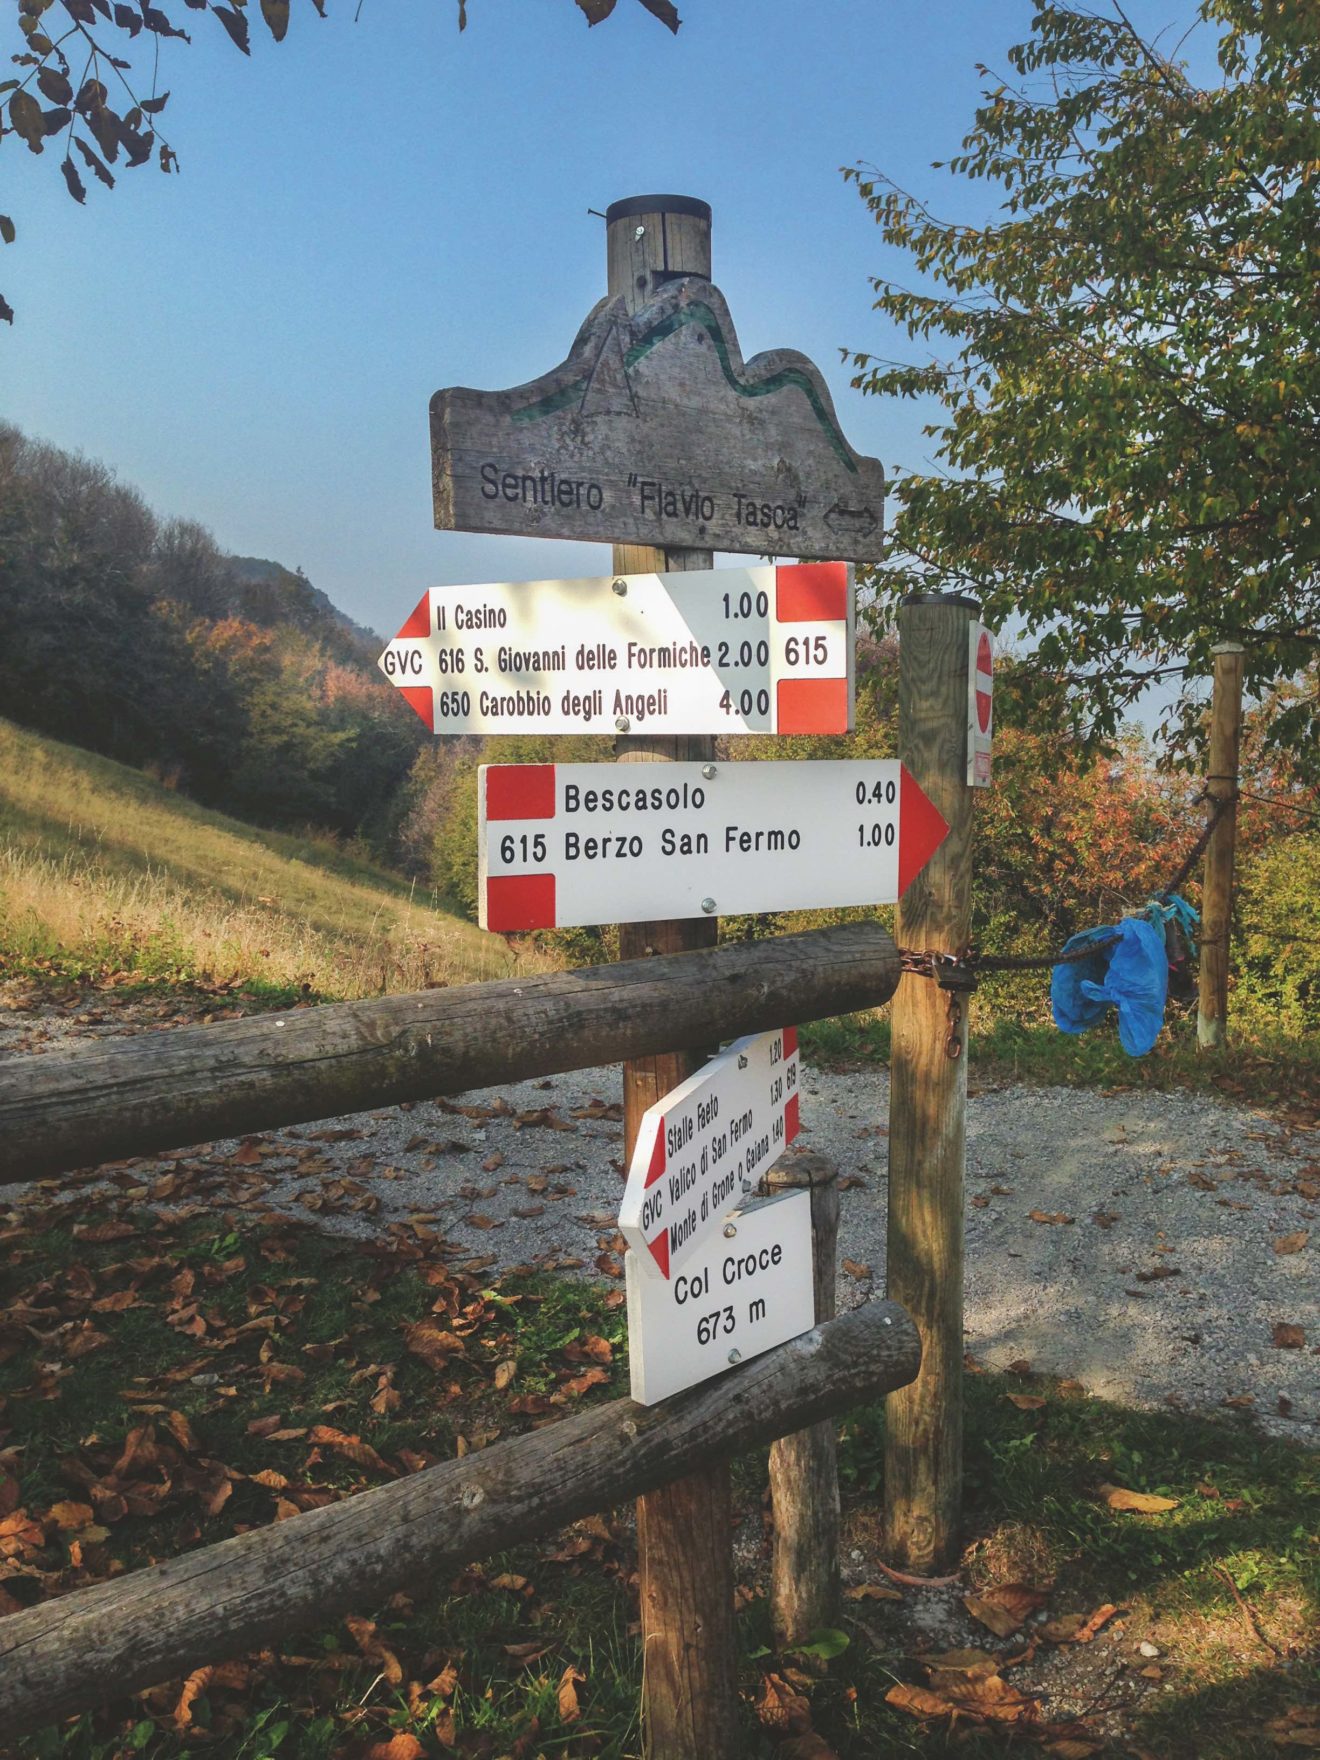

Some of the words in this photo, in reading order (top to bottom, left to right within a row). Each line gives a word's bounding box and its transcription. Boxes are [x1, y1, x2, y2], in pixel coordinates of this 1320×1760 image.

[480, 462, 603, 511] Sentiero
[454, 603, 508, 631] Casino
[722, 591, 769, 619] 1.00
[384, 649, 423, 676] GVC
[438, 648, 466, 674] 616
[474, 647, 489, 673] S.
[498, 645, 566, 673] Giovanni
[575, 643, 617, 671] delle
[627, 641, 711, 669] Formiche
[717, 640, 769, 668] 2.00
[784, 636, 828, 666] 615
[440, 691, 471, 718] 650
[479, 690, 552, 717] Carobbio
[561, 689, 603, 722] degli
[612, 688, 668, 721] Angeli
[719, 689, 770, 716] 4.00
[564, 782, 706, 814] Bescasolo
[855, 780, 897, 805] 0.40
[499, 833, 547, 865] 615
[564, 831, 643, 861] Berzo
[661, 827, 709, 857] San
[725, 825, 801, 853] Fermo
[857, 823, 896, 848] 1.00
[786, 1062, 797, 1091] 619
[667, 1115, 694, 1159] Stalle
[697, 1093, 719, 1132] Faeto
[769, 1037, 782, 1067] 1.20
[668, 1161, 697, 1205] Valico
[700, 1144, 709, 1177] di
[711, 1132, 727, 1165] San
[729, 1109, 753, 1148] Fermo
[770, 1076, 783, 1107] 1.30
[670, 1207, 697, 1256] Monte
[701, 1192, 709, 1223] di
[712, 1169, 735, 1210] Grone
[772, 1115, 784, 1146] 1.40
[642, 1189, 662, 1231] GVC
[674, 1266, 709, 1305] Col
[722, 1243, 783, 1285] Croce
[697, 1305, 736, 1346] 673
[749, 1298, 766, 1324] m
